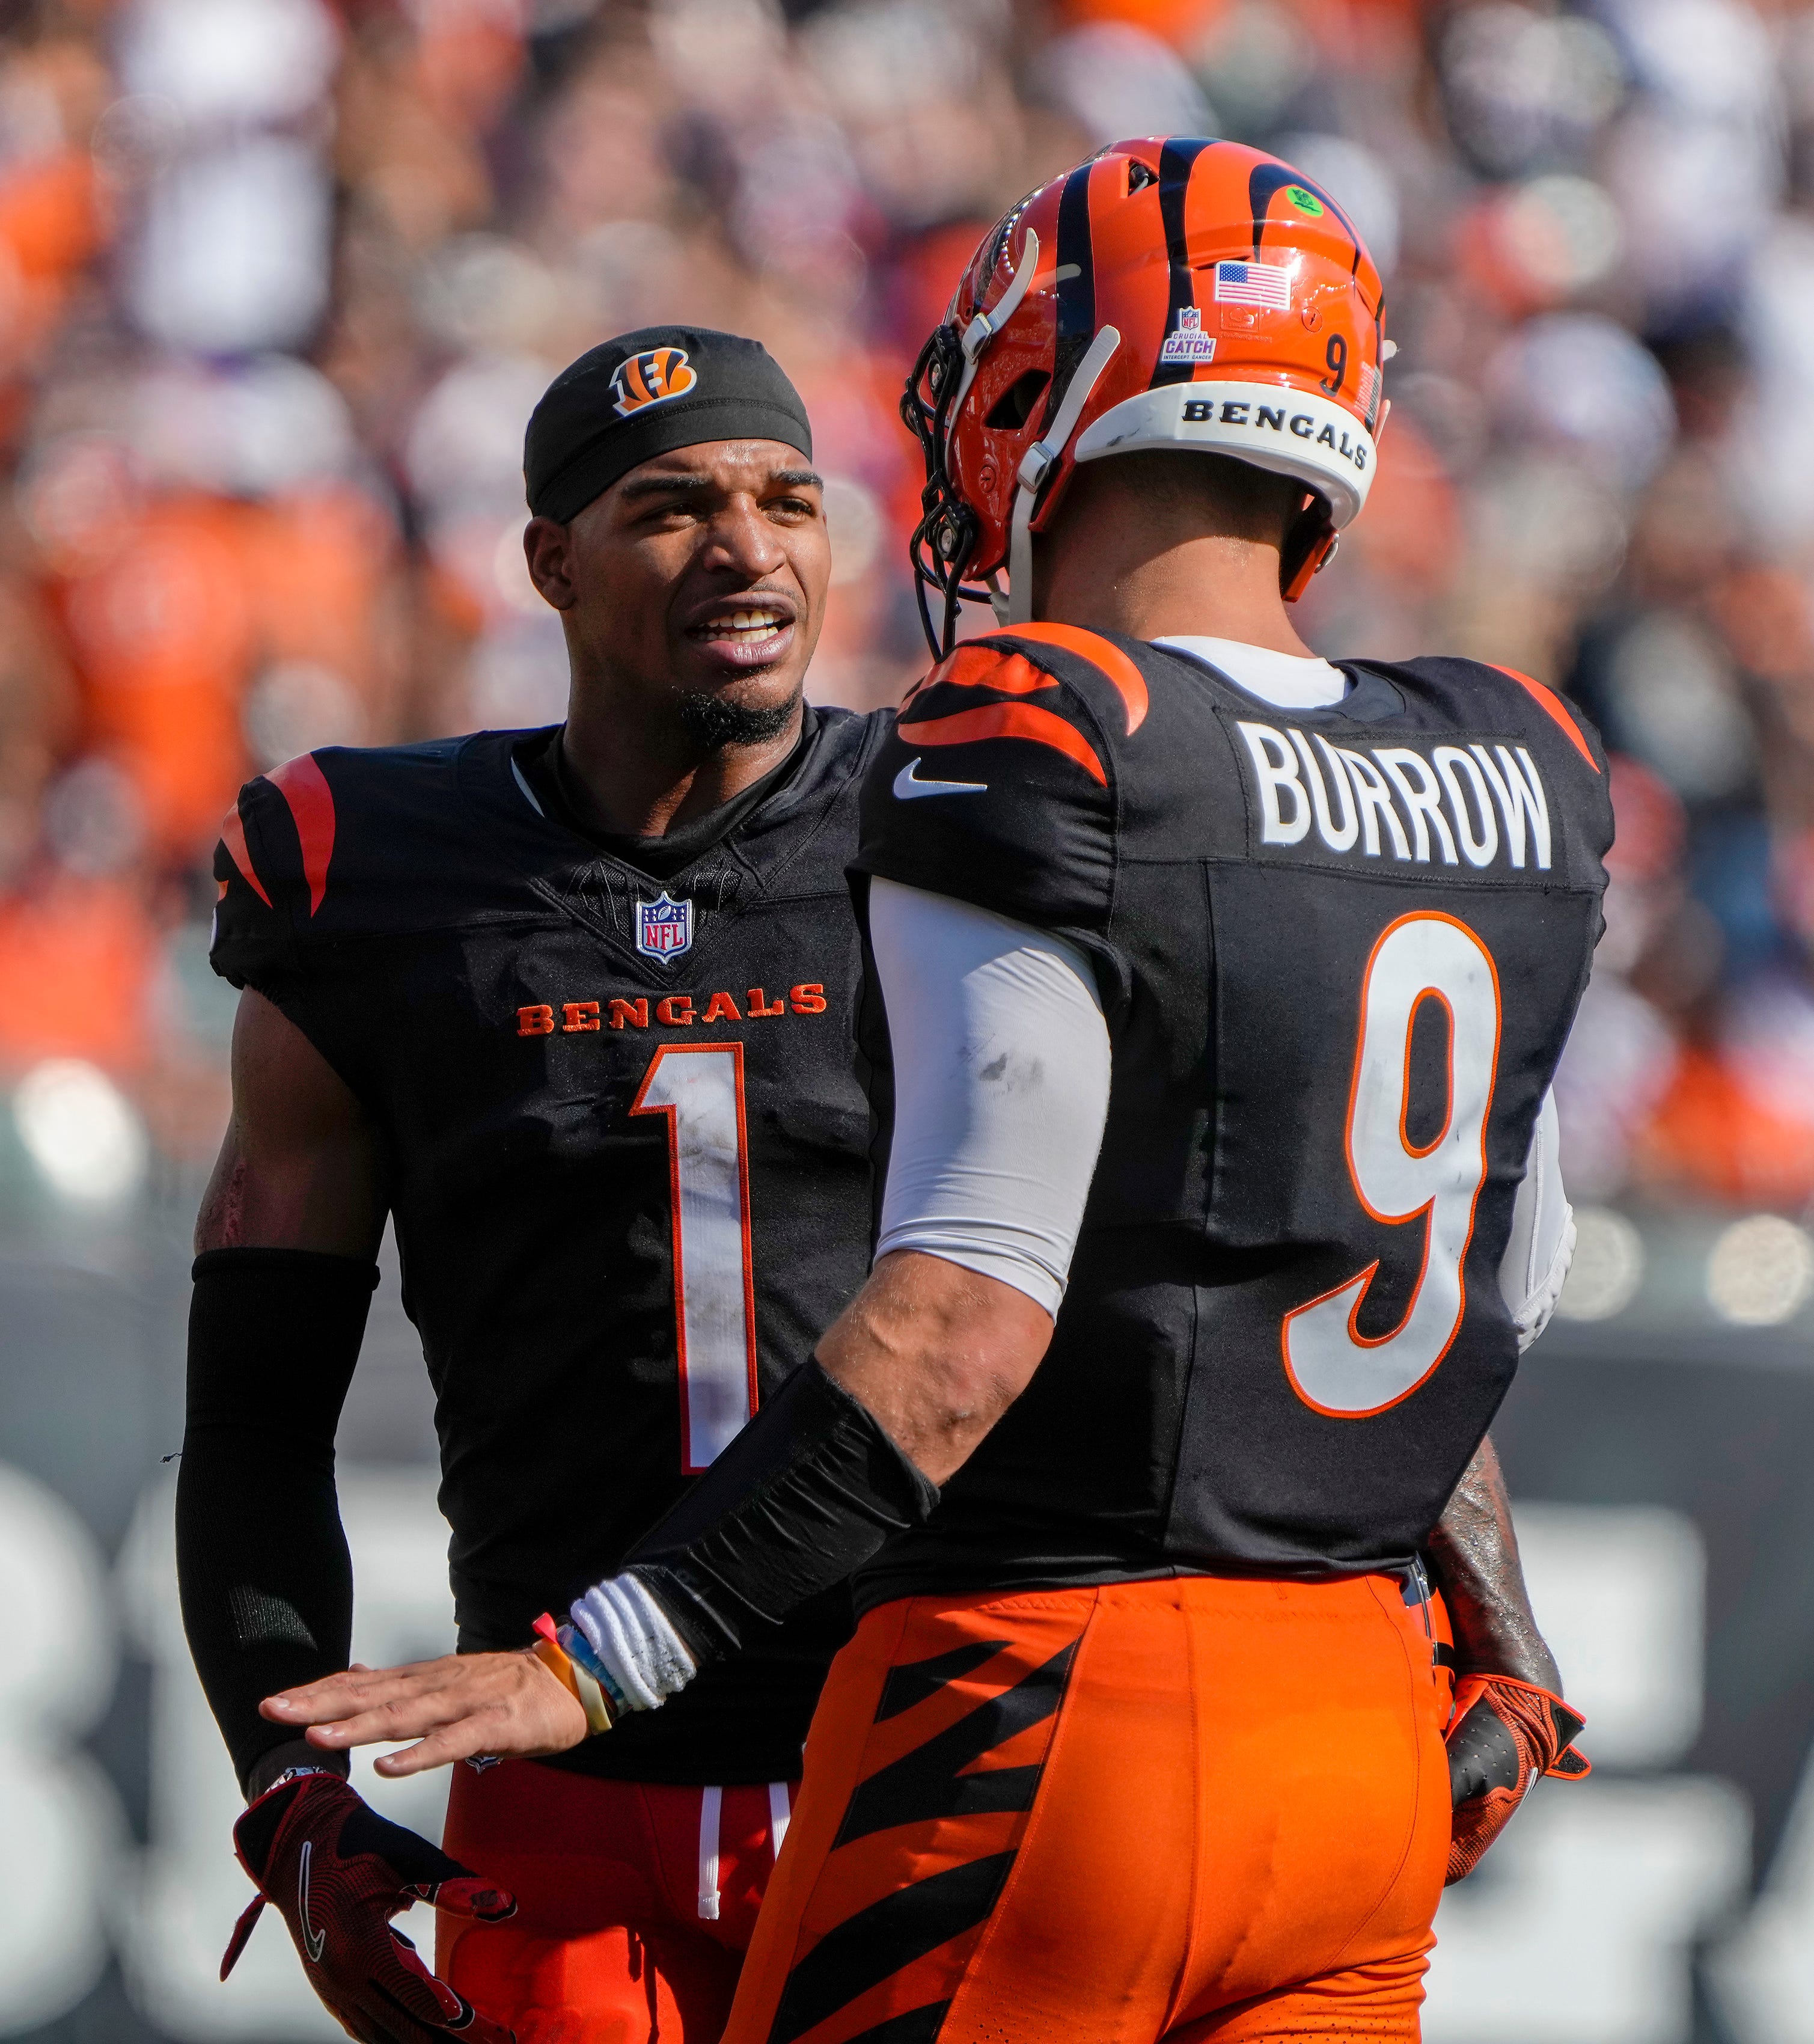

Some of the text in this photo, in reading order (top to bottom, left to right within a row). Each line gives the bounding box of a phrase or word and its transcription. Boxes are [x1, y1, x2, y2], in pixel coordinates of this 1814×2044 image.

[1166, 340, 1213, 353] CATCH
[1183, 317, 1197, 328] NFL
[1319, 333, 1348, 397] 9
[1181, 399, 1368, 471] BENGALS
[1236, 721, 1552, 871] BURROW
[644, 923, 684, 951] NFL
[516, 983, 828, 1038] BENGALS
[1281, 910, 1503, 1419] 9
[628, 1041, 759, 1475] 1
